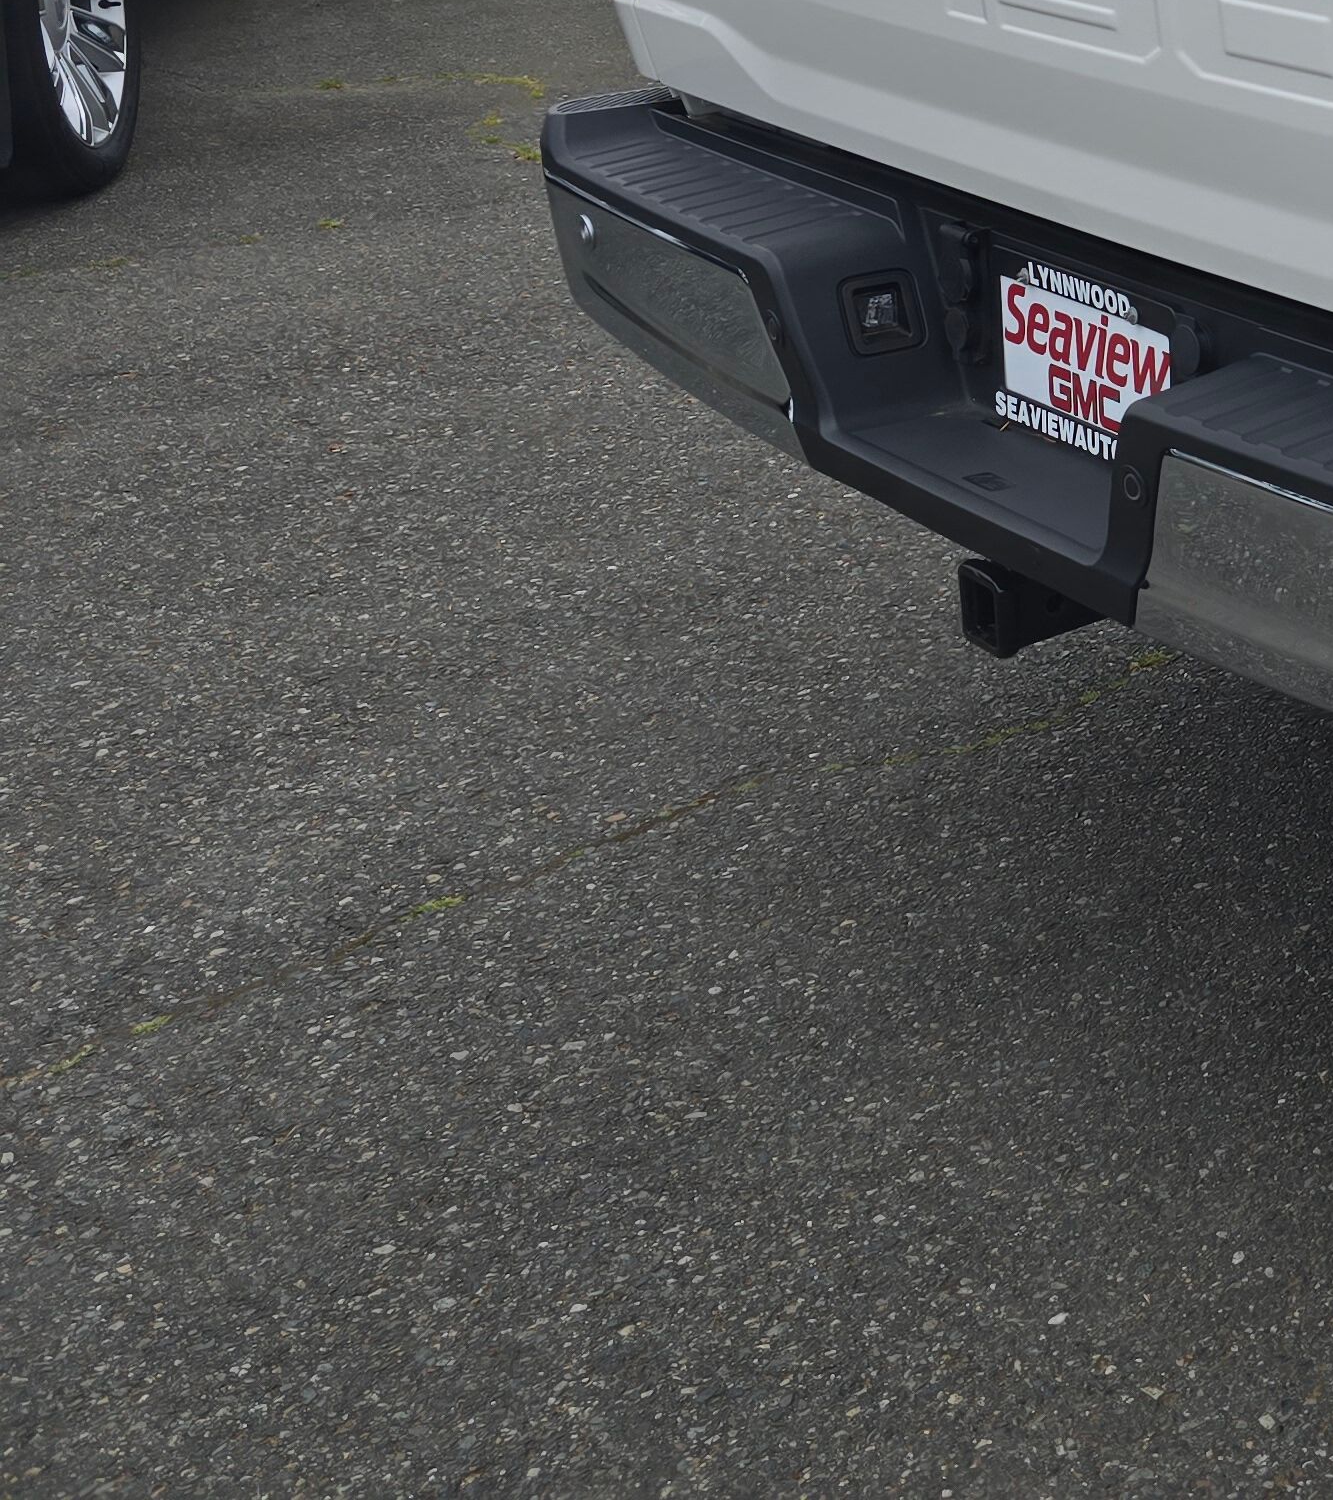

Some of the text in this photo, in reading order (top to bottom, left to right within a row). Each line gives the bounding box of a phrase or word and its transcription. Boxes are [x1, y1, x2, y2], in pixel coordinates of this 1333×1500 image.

[1028, 261, 1132, 318] LYNNWOOD
[1004, 283, 1171, 396] Seaview
[1049, 363, 1121, 432] GMC
